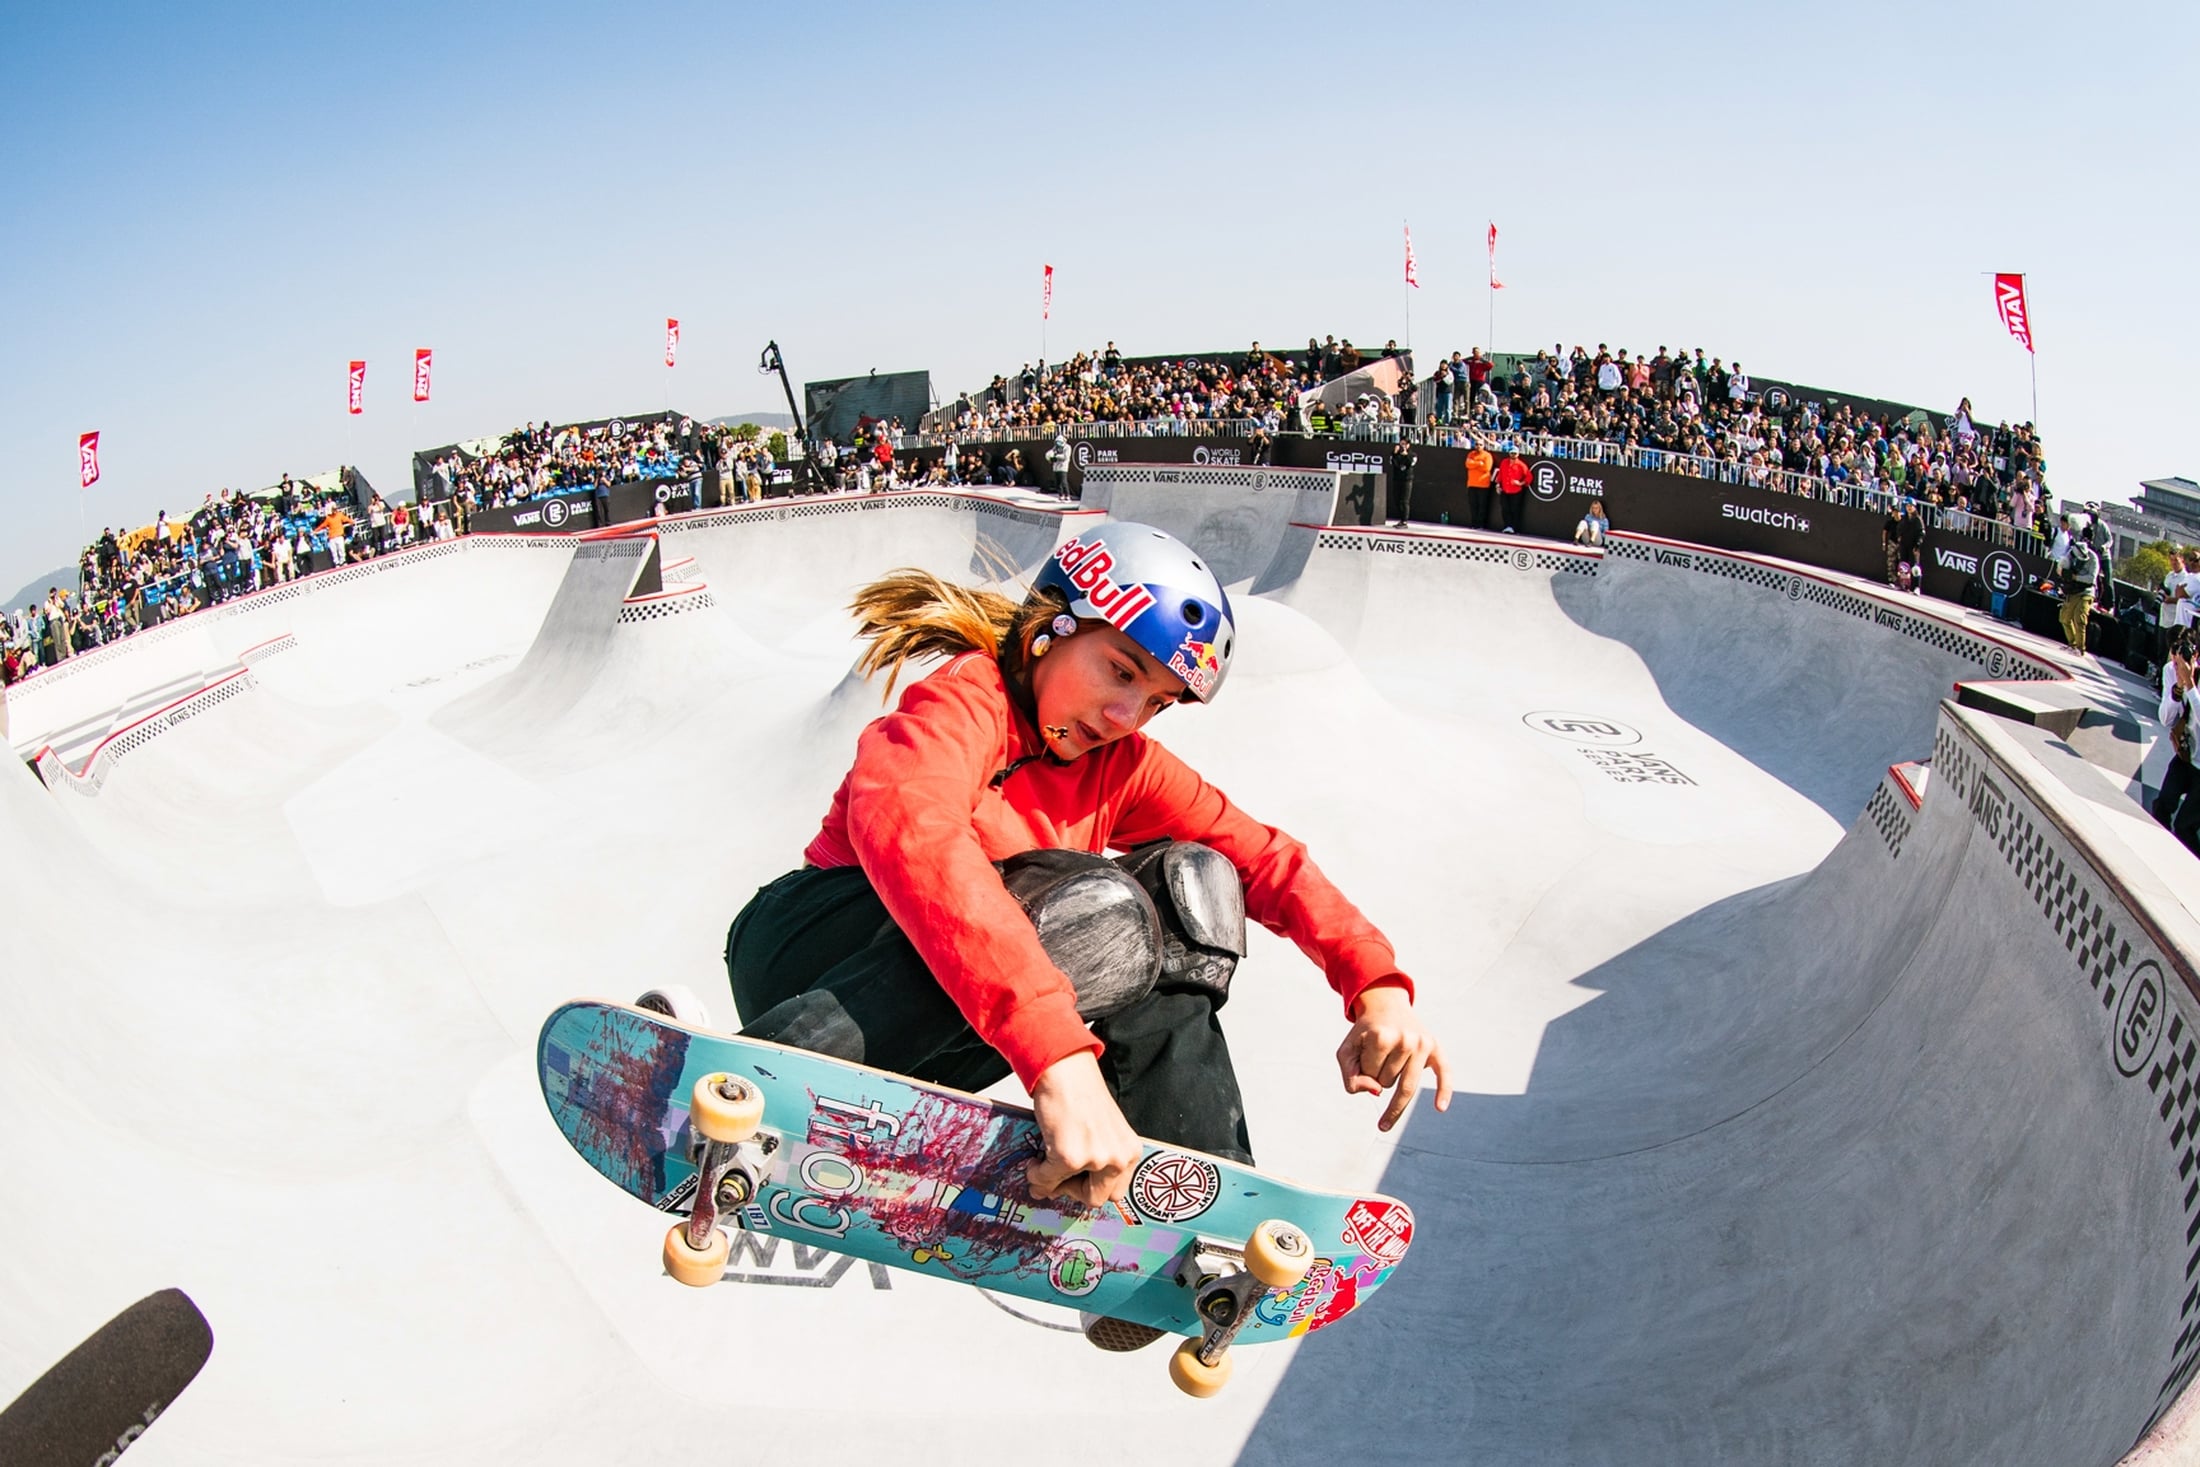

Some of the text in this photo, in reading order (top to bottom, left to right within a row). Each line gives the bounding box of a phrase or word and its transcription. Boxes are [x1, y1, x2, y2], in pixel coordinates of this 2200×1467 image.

[1210, 448, 1240, 457] WORLD
[1211, 456, 1240, 466] SKATE
[1326, 451, 1383, 464] GoPro
[1152, 471, 1180, 483] VANS
[1570, 476, 1603, 489] PARK
[1570, 486, 1603, 496] SERIES
[859, 499, 886, 511] VANS
[513, 511, 541, 526] VANS
[686, 518, 709, 530] VANS
[1722, 503, 1796, 531] swatch
[526, 539, 549, 548] VANS
[1367, 538, 1405, 553] VANS
[376, 559, 399, 572] VANS
[1654, 548, 1692, 569] VANS
[1934, 547, 1978, 575] VANS
[1056, 539, 1152, 630] ed Bull
[1874, 606, 1904, 631] VANS
[1170, 653, 1212, 696] Red Bull
[164, 707, 190, 727] VANS
[1576, 748, 1632, 783] SERIES
[1596, 750, 1660, 784] PARK
[1622, 752, 1699, 787] VANS
[1968, 763, 2007, 840] VANS
[1135, 1159, 1177, 1218] TRUCK COMPANY
[747, 1207, 769, 1226] 187
[1380, 1204, 1412, 1235] VANS
[1363, 1221, 1395, 1251] THE
[1288, 1266, 1331, 1323] Red Bull
